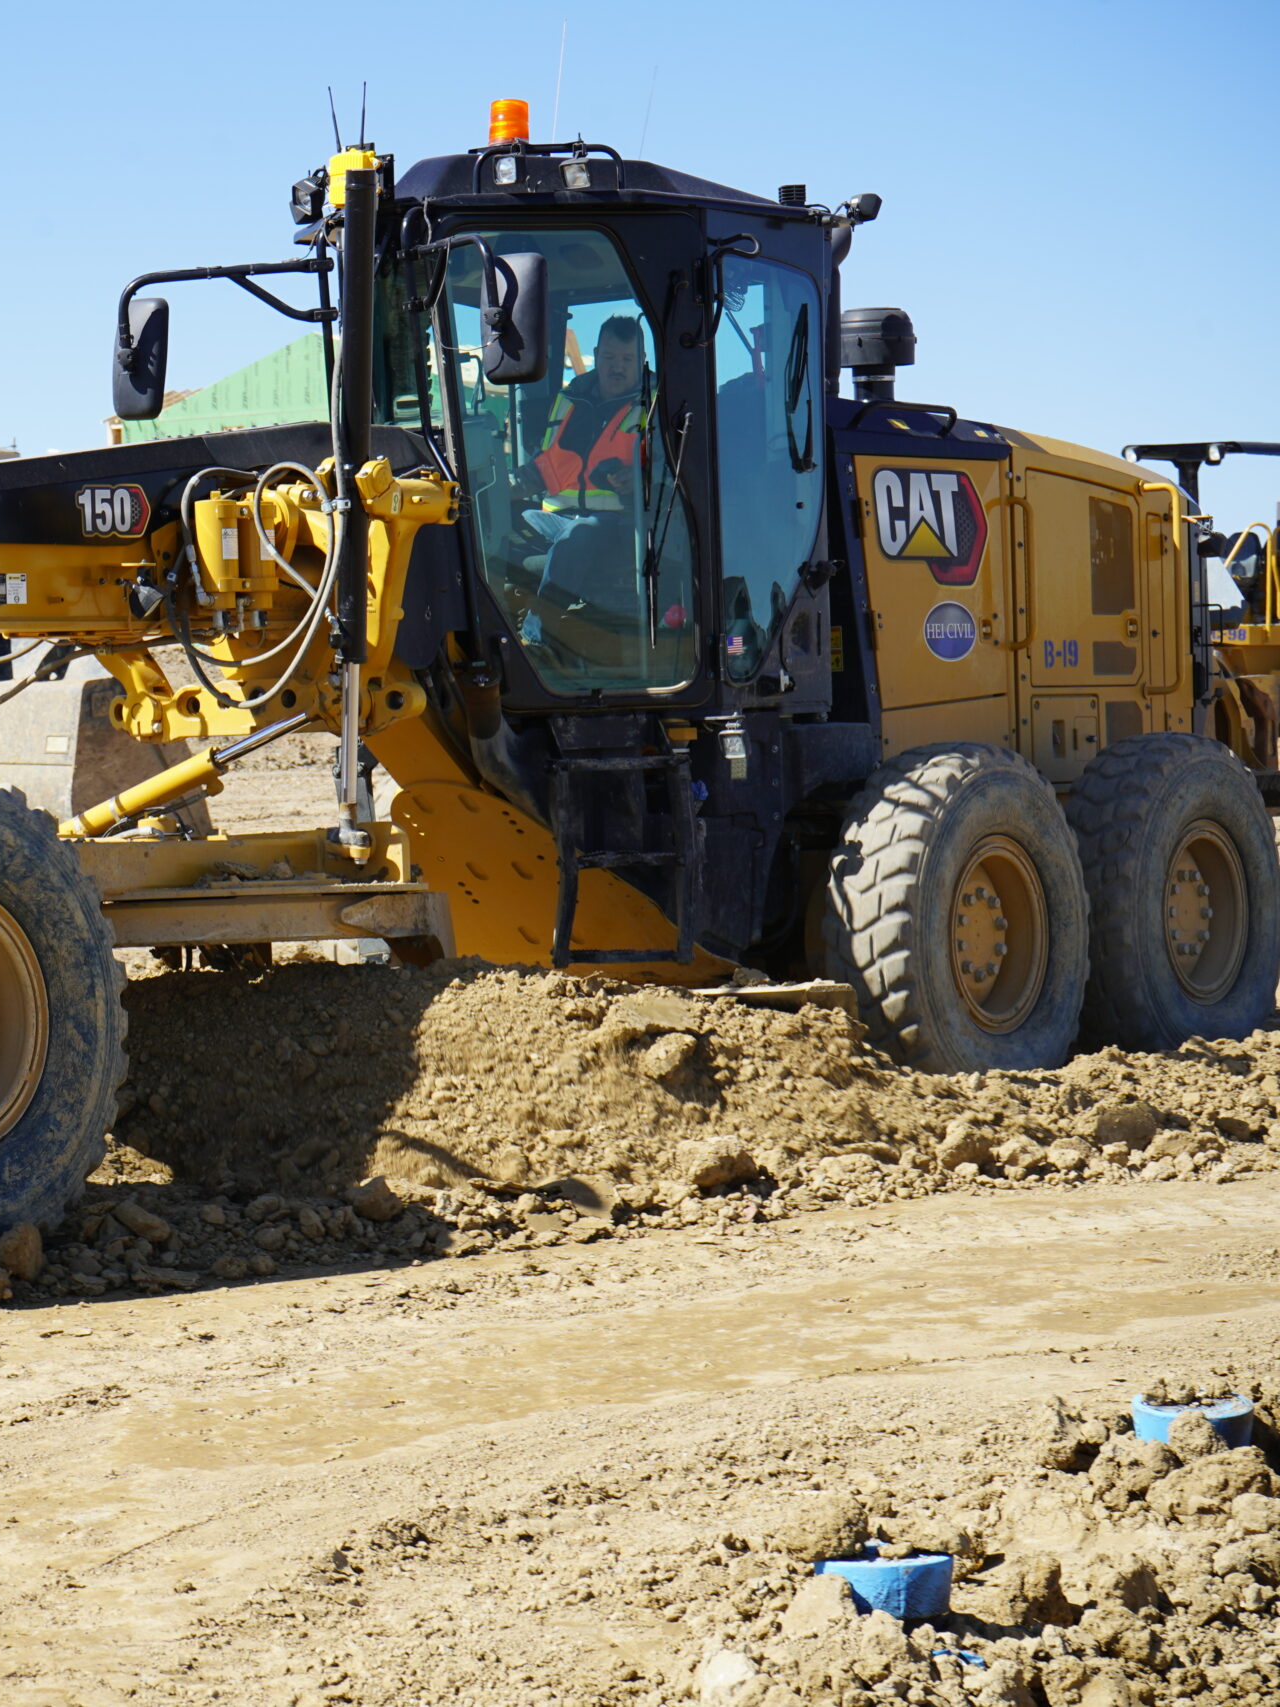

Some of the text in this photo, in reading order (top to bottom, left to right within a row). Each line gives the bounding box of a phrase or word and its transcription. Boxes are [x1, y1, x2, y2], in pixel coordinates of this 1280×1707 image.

[78, 488, 131, 532] 150
[874, 469, 959, 557] CAT
[926, 623, 974, 639] HEI CIVIL
[1044, 640, 1079, 668] B-19
